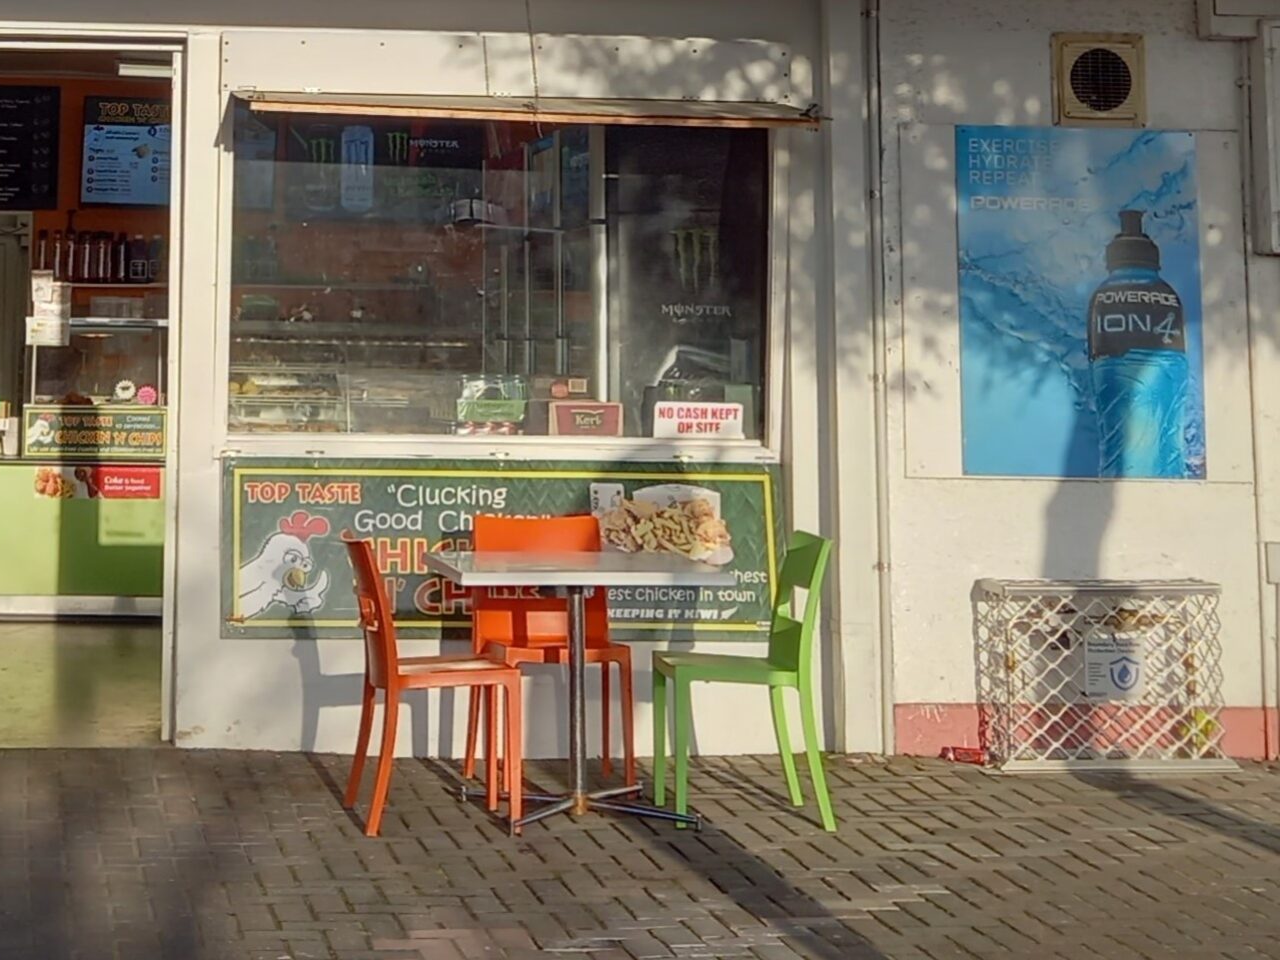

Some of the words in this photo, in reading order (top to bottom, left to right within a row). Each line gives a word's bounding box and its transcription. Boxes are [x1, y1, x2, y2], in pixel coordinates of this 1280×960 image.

[98, 102, 129, 116] TOP
[968, 138, 1059, 153] EXERCISE
[968, 154, 1053, 169] HYDRATE
[969, 170, 1040, 186] REPEAT
[970, 196, 1091, 211] POWERADE
[1096, 290, 1179, 307] POWERADE
[660, 302, 733, 318] MONSTER
[658, 407, 674, 419] NO
[677, 407, 708, 419] CASH
[711, 407, 739, 420] KEPT
[695, 422, 721, 434] SITE
[244, 482, 291, 504] TOP
[295, 482, 362, 505] TASTE
[387, 483, 508, 509] "Clucking
[354, 509, 422, 533] Good
[699, 586, 713, 602] in
[718, 588, 756, 603] town
